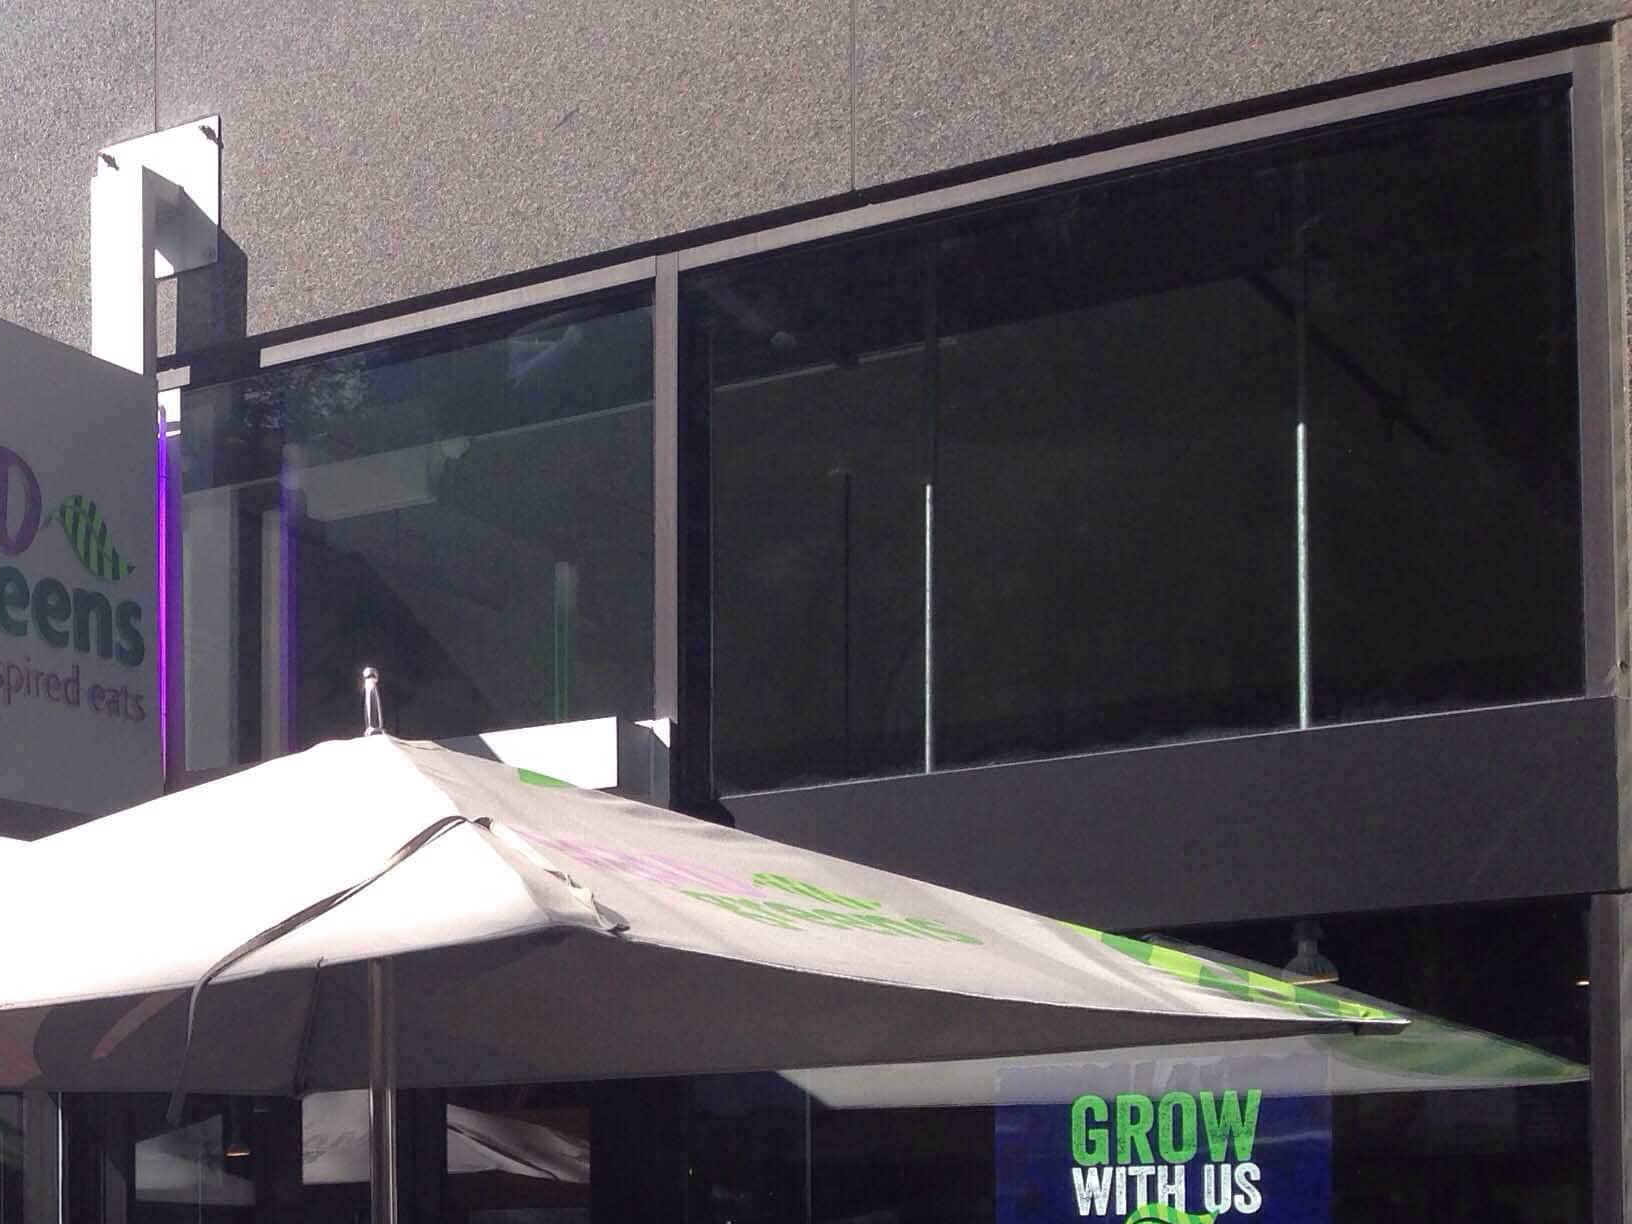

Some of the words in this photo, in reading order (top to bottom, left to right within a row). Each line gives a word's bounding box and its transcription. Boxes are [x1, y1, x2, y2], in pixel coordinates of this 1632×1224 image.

[88, 683, 147, 723] eats
[1071, 1089, 1262, 1166] GROW
[1072, 1165, 1186, 1216] WITH
[1204, 1162, 1262, 1214] US
